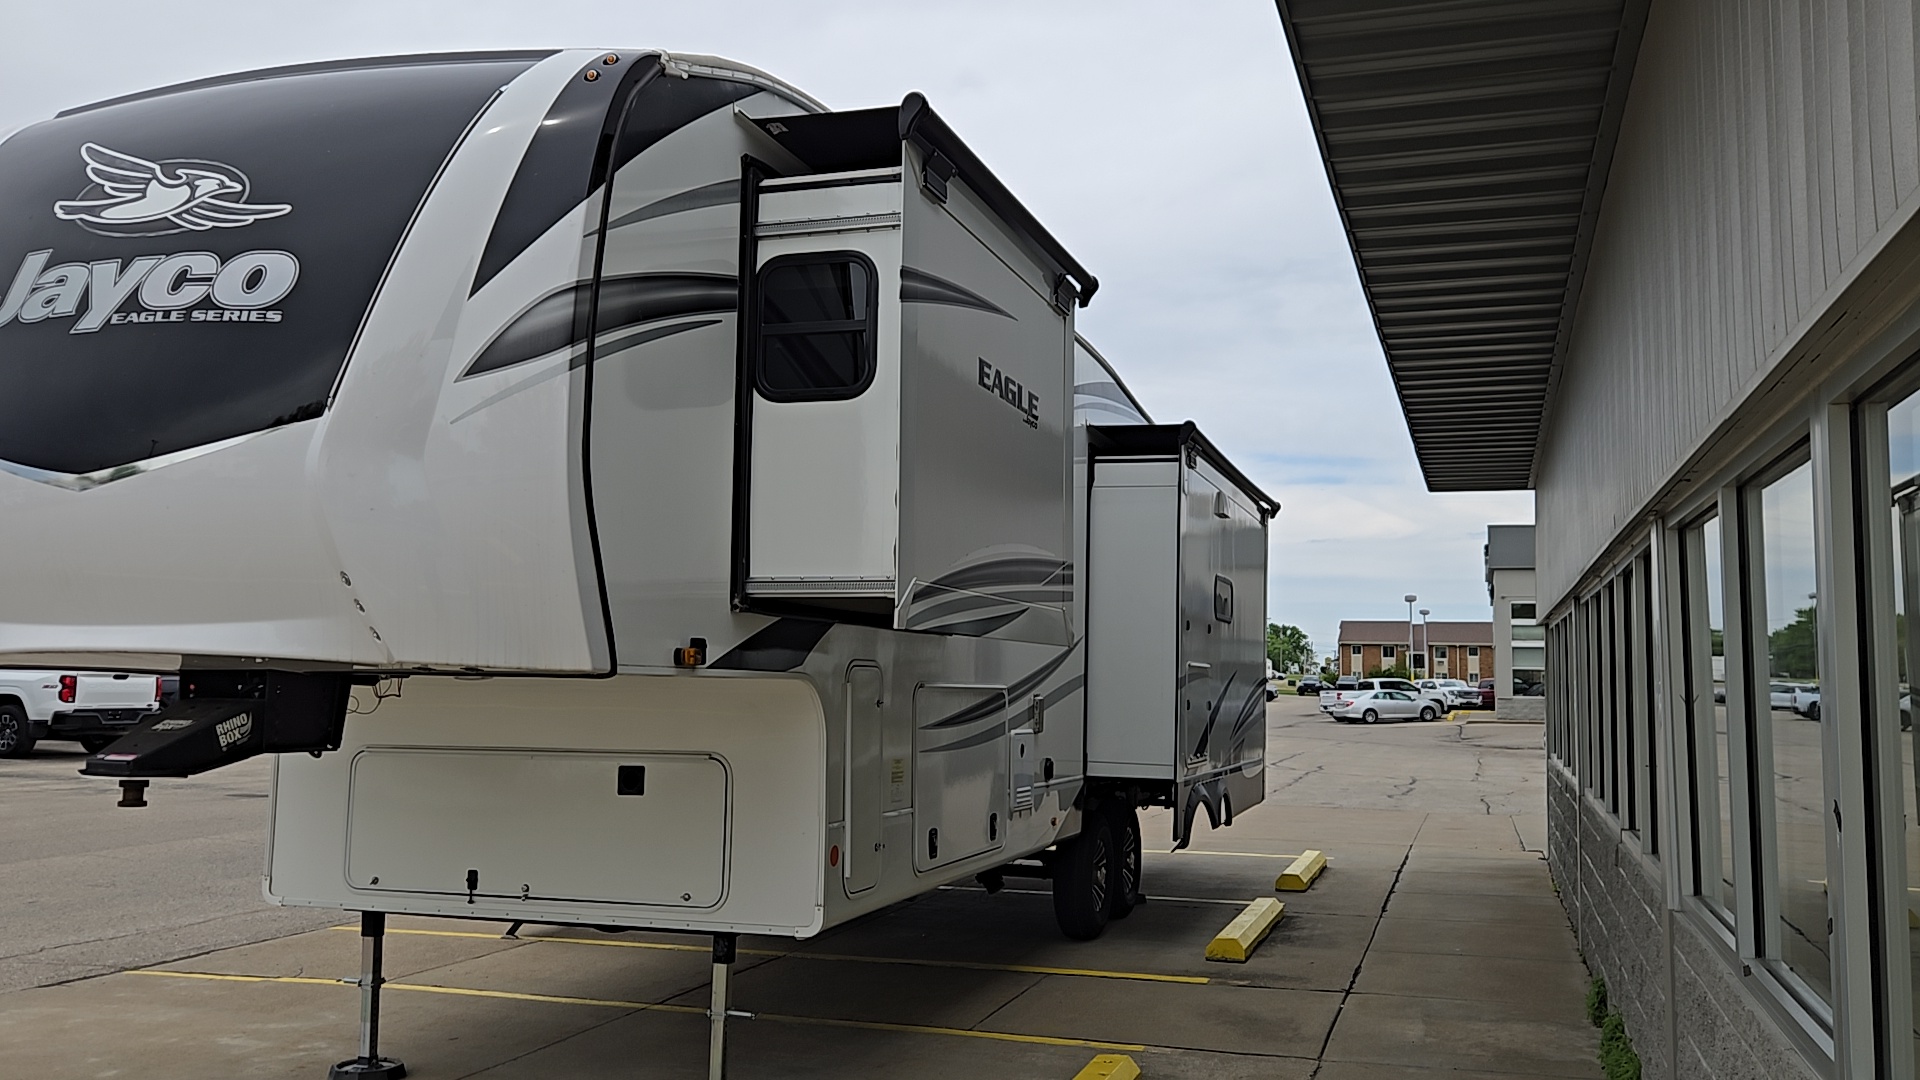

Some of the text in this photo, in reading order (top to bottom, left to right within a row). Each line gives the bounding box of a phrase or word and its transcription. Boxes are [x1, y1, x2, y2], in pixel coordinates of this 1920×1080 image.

[0, 249, 299, 334] Jayco
[110, 309, 283, 325] EAGLE SERIES
[978, 356, 1040, 422] EAGLE
[215, 712, 248, 736] RHINO
[218, 727, 243, 747] BOX
